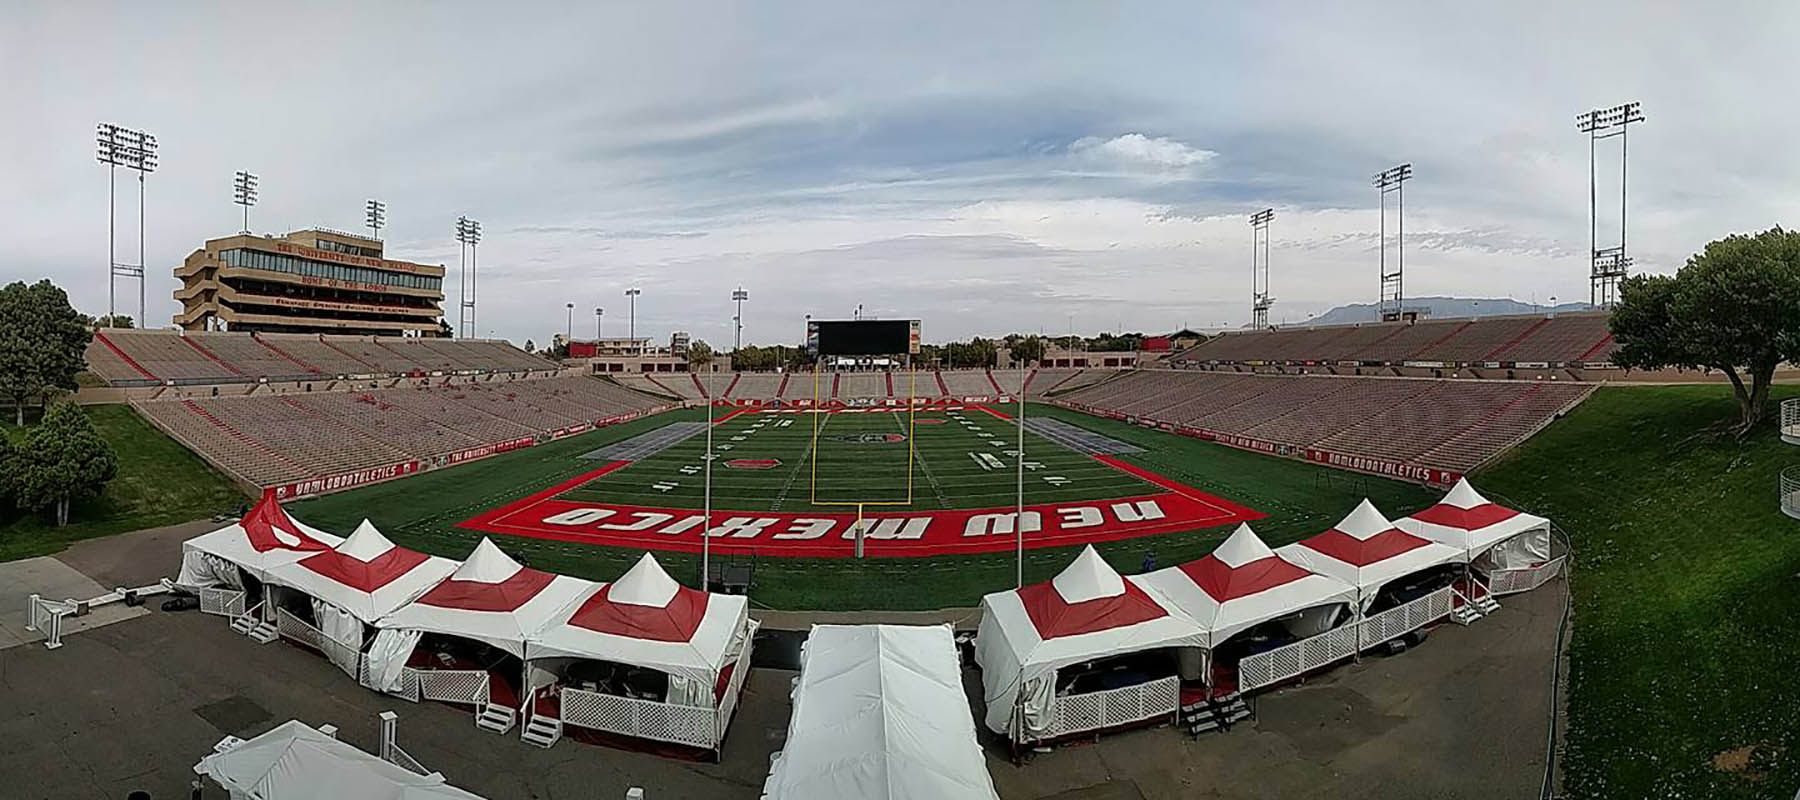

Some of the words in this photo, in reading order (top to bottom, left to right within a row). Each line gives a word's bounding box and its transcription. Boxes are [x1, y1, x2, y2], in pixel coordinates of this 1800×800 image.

[278, 243, 291, 253] THE
[298, 246, 344, 262] UNIVERSITY
[351, 256, 361, 264] OF
[302, 276, 321, 285] HOME
[328, 279, 338, 287] OF
[345, 281, 359, 290] THE
[364, 283, 388, 292] LOBOS
[542, 508, 931, 540] MEXICO
[963, 500, 1165, 537] NEW
